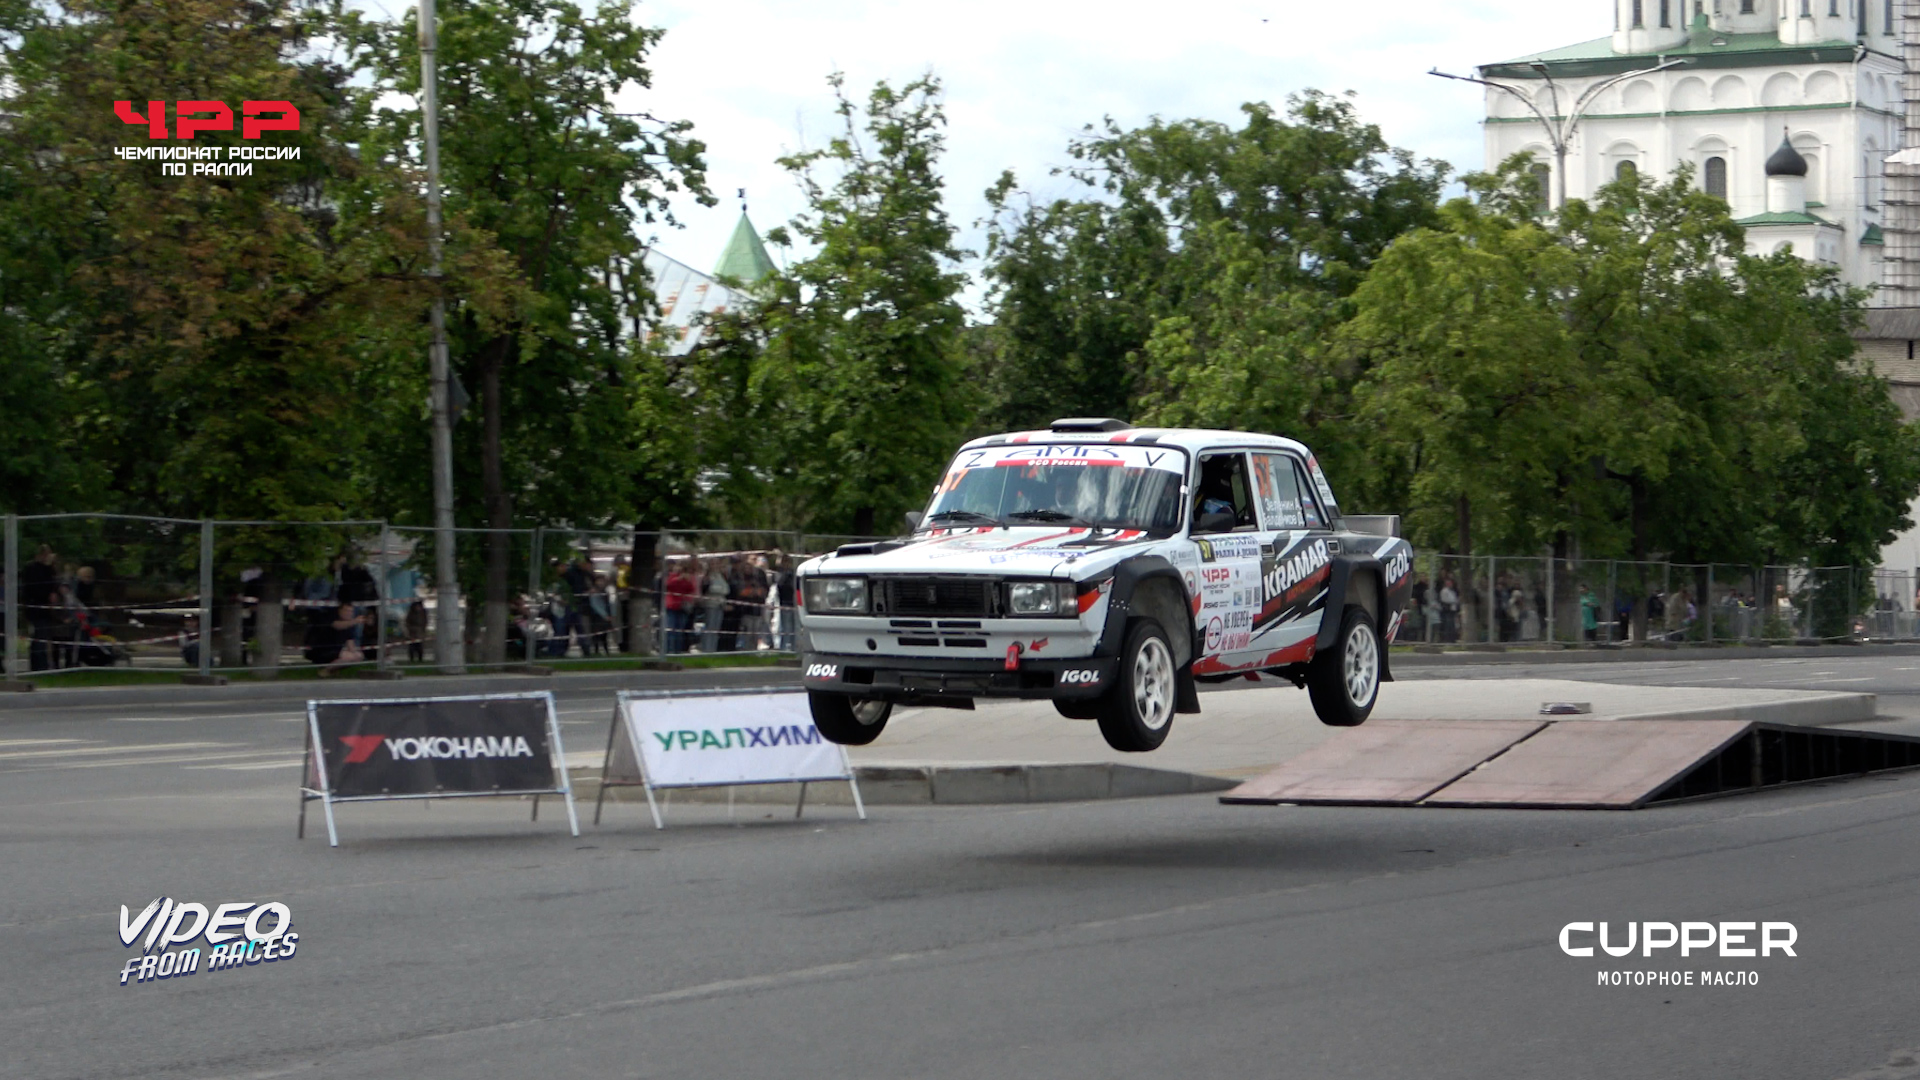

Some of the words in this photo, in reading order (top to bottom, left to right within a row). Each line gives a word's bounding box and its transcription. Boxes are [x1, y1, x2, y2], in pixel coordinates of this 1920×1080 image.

[965, 452, 986, 468] Z
[1145, 451, 1166, 467] V
[1264, 538, 1330, 602] KRAMAR
[1385, 549, 1410, 587] IGOL
[805, 663, 838, 678] IGOL
[1060, 669, 1100, 684] IGOL
[384, 735, 534, 760] YOKOHAMA
[653, 726, 821, 752] УРАЛХИМ
